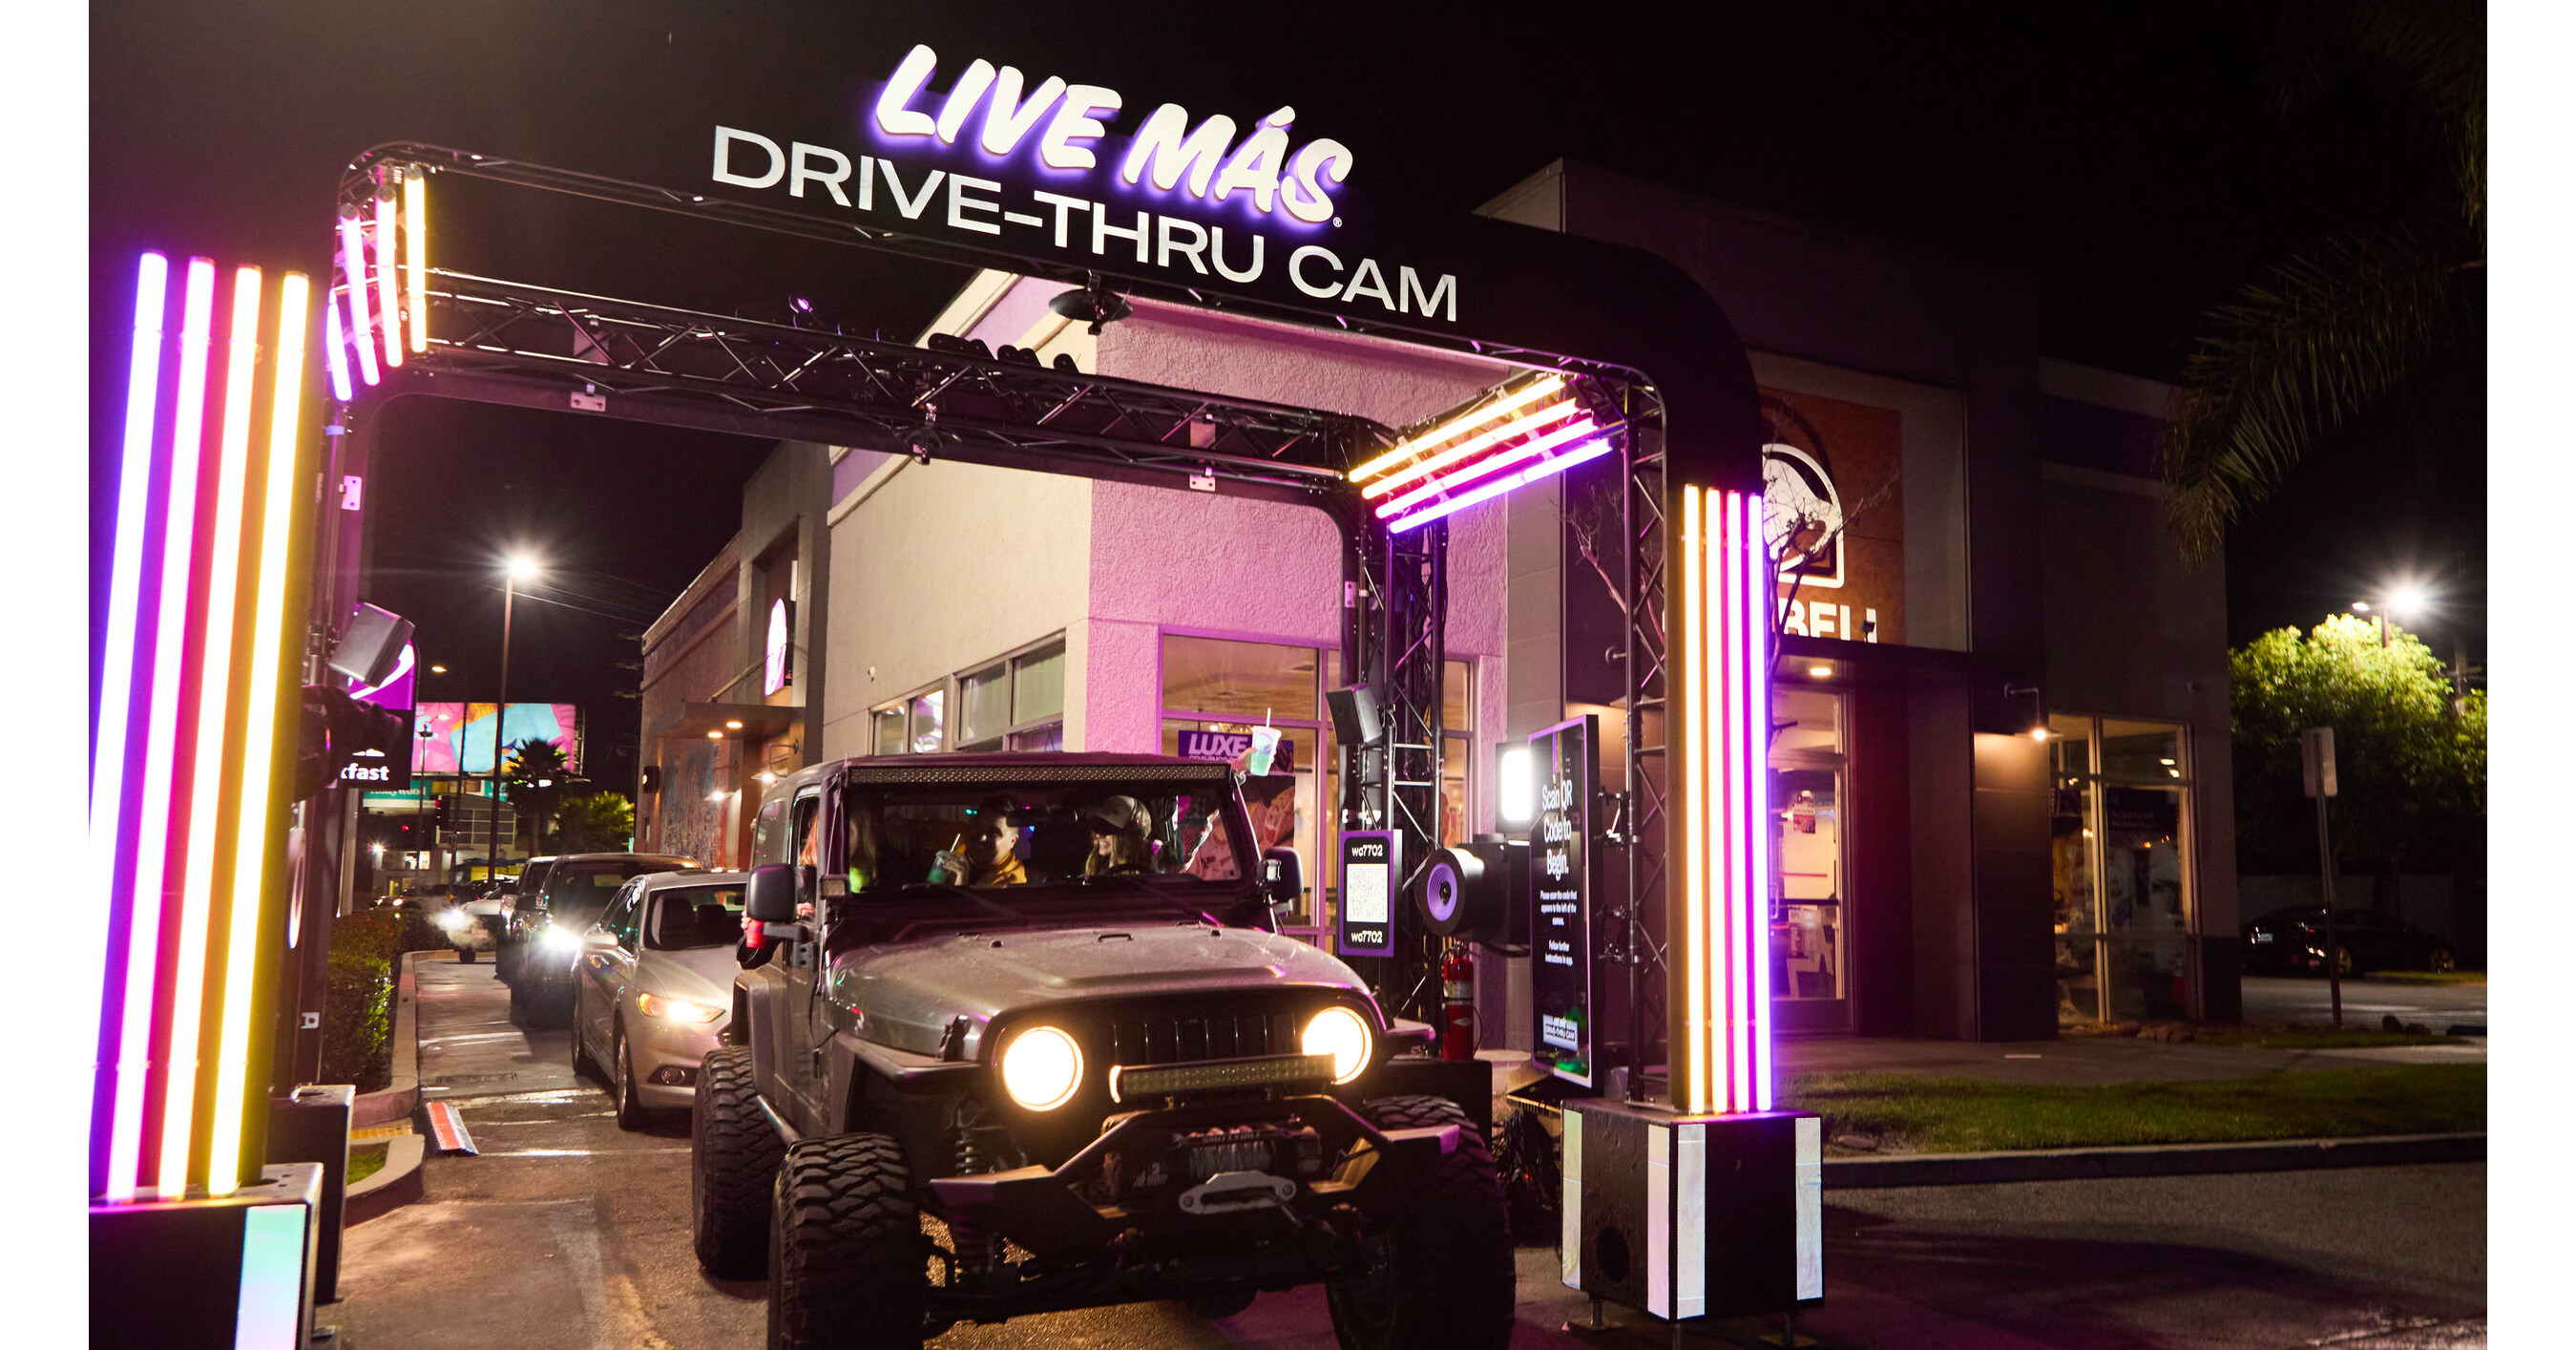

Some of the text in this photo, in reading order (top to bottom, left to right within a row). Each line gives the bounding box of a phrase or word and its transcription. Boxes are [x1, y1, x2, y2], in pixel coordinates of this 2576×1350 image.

[875, 44, 1353, 223] LIVE MÁS
[712, 125, 1456, 323] DRIVE-THRU CAM
[1188, 733, 1248, 756] LUXE
[1542, 779, 1573, 812] Scan QR
[1544, 816, 1572, 843] Code to
[1547, 848, 1569, 881] Begin.
